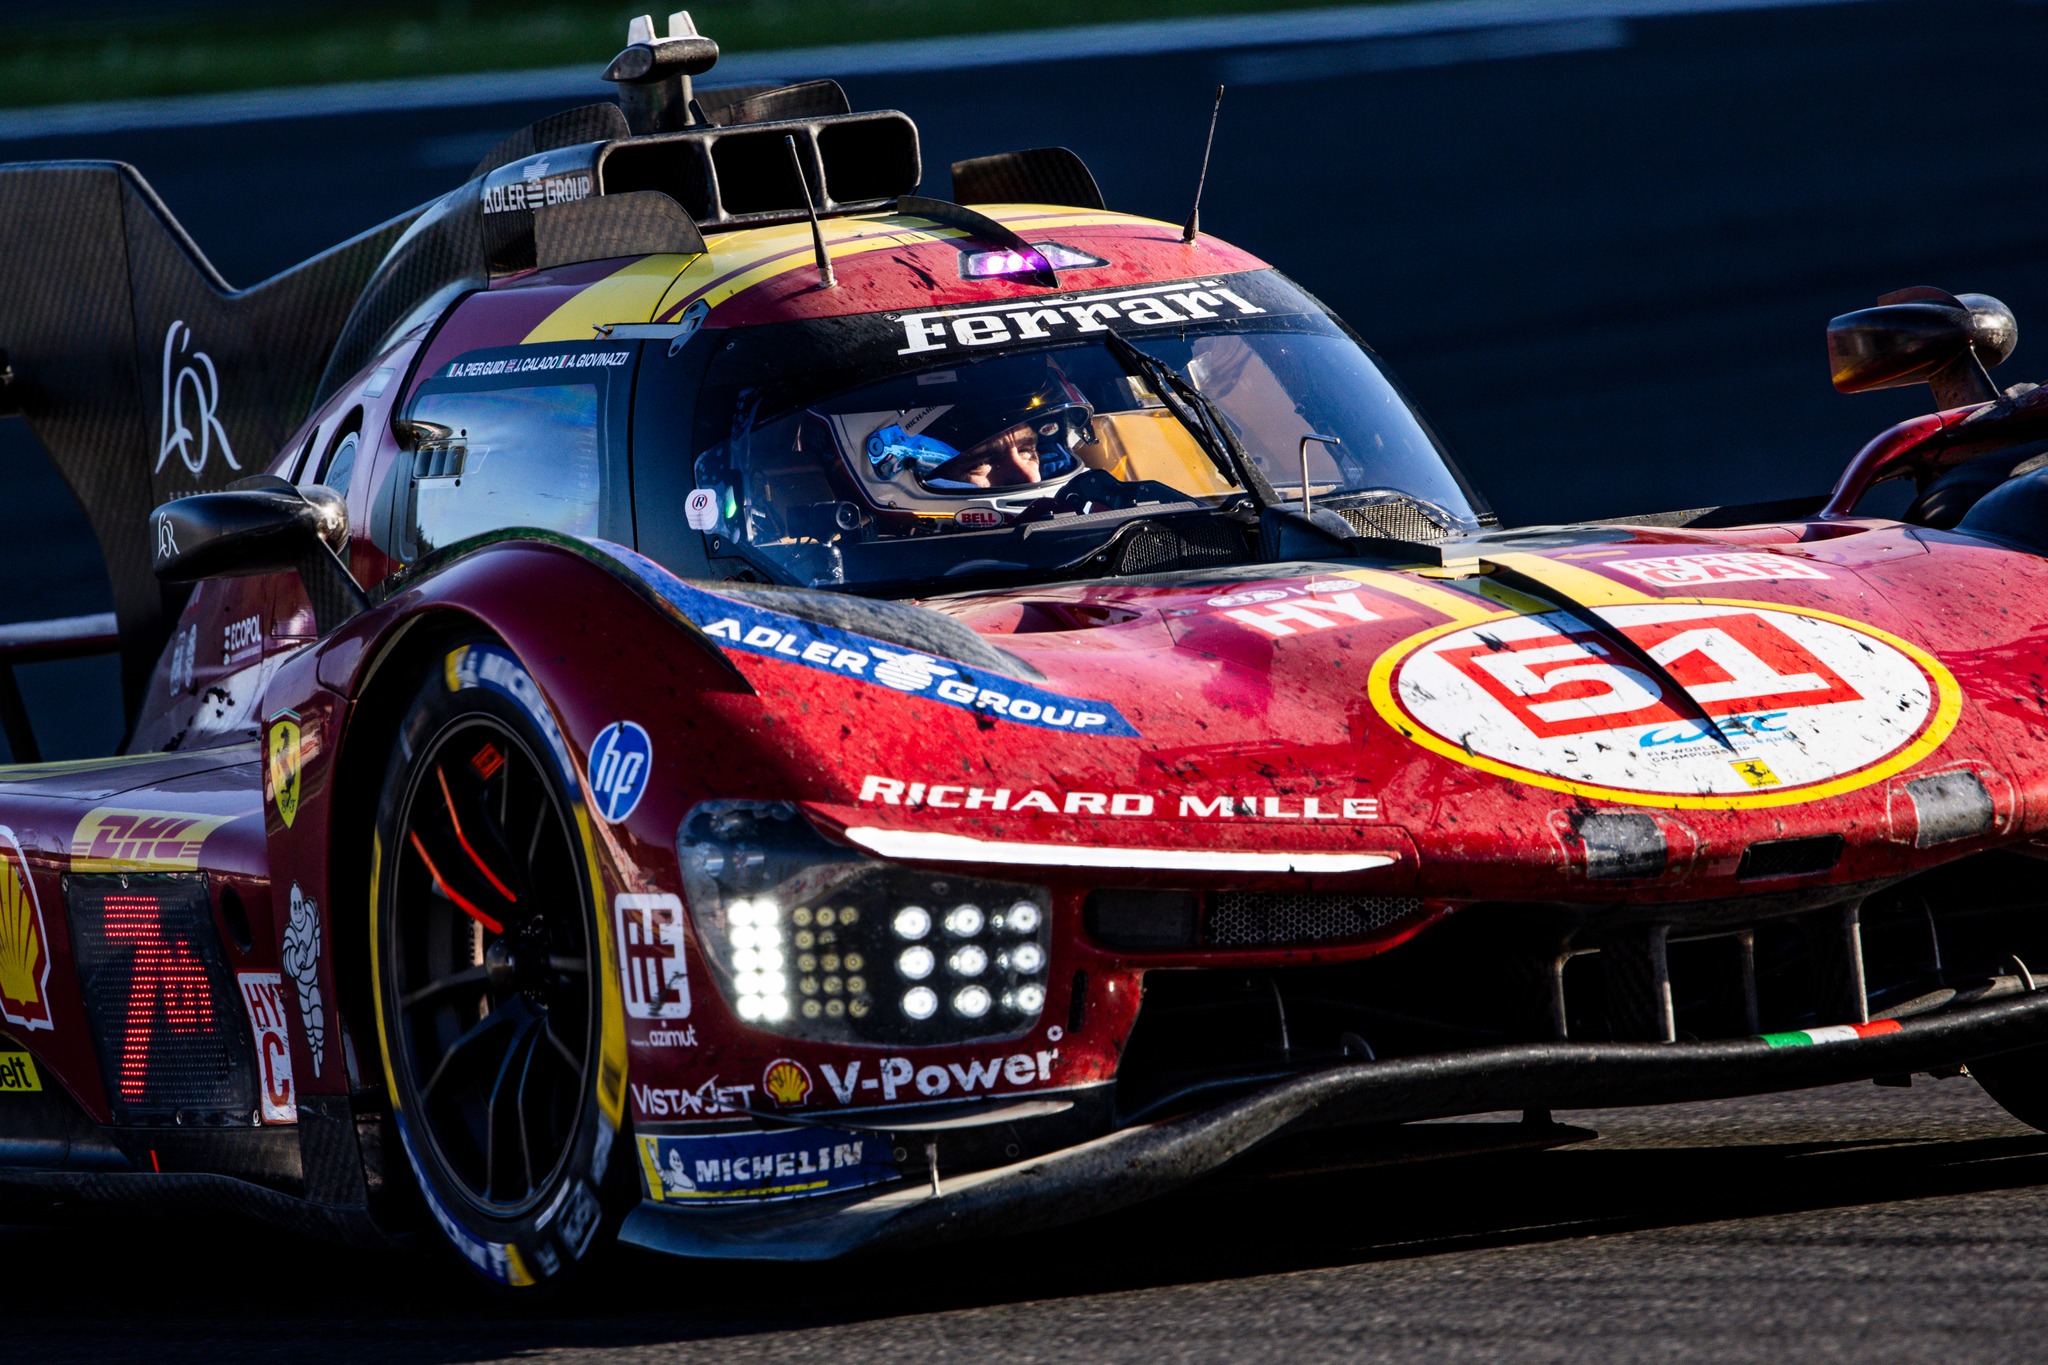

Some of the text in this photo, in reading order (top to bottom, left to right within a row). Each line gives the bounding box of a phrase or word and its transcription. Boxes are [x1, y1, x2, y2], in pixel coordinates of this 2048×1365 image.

[483, 175, 591, 214] ADLER GROUP
[895, 280, 1267, 355] Ferrari
[521, 355, 560, 372] CALADO
[576, 352, 631, 368] GIOVINAZZI
[961, 512, 997, 524] BELL
[1619, 553, 1783, 571] HYPER
[1642, 563, 1815, 584] CAR
[230, 614, 262, 652] ECOPOL
[701, 618, 1108, 729] ADLER GROUP
[1470, 628, 1834, 723] 51
[1651, 745, 1751, 763] CHAMPIONSIP
[1671, 744, 1719, 755] WORLD
[594, 724, 646, 821] hp
[857, 774, 1380, 820] RICHARD MILLE
[87, 814, 202, 860] DHL
[648, 1020, 699, 1048] azimut
[0, 1055, 33, 1089] elt
[819, 1047, 1060, 1104] V-Power
[694, 1140, 865, 1184] MICHELIN
